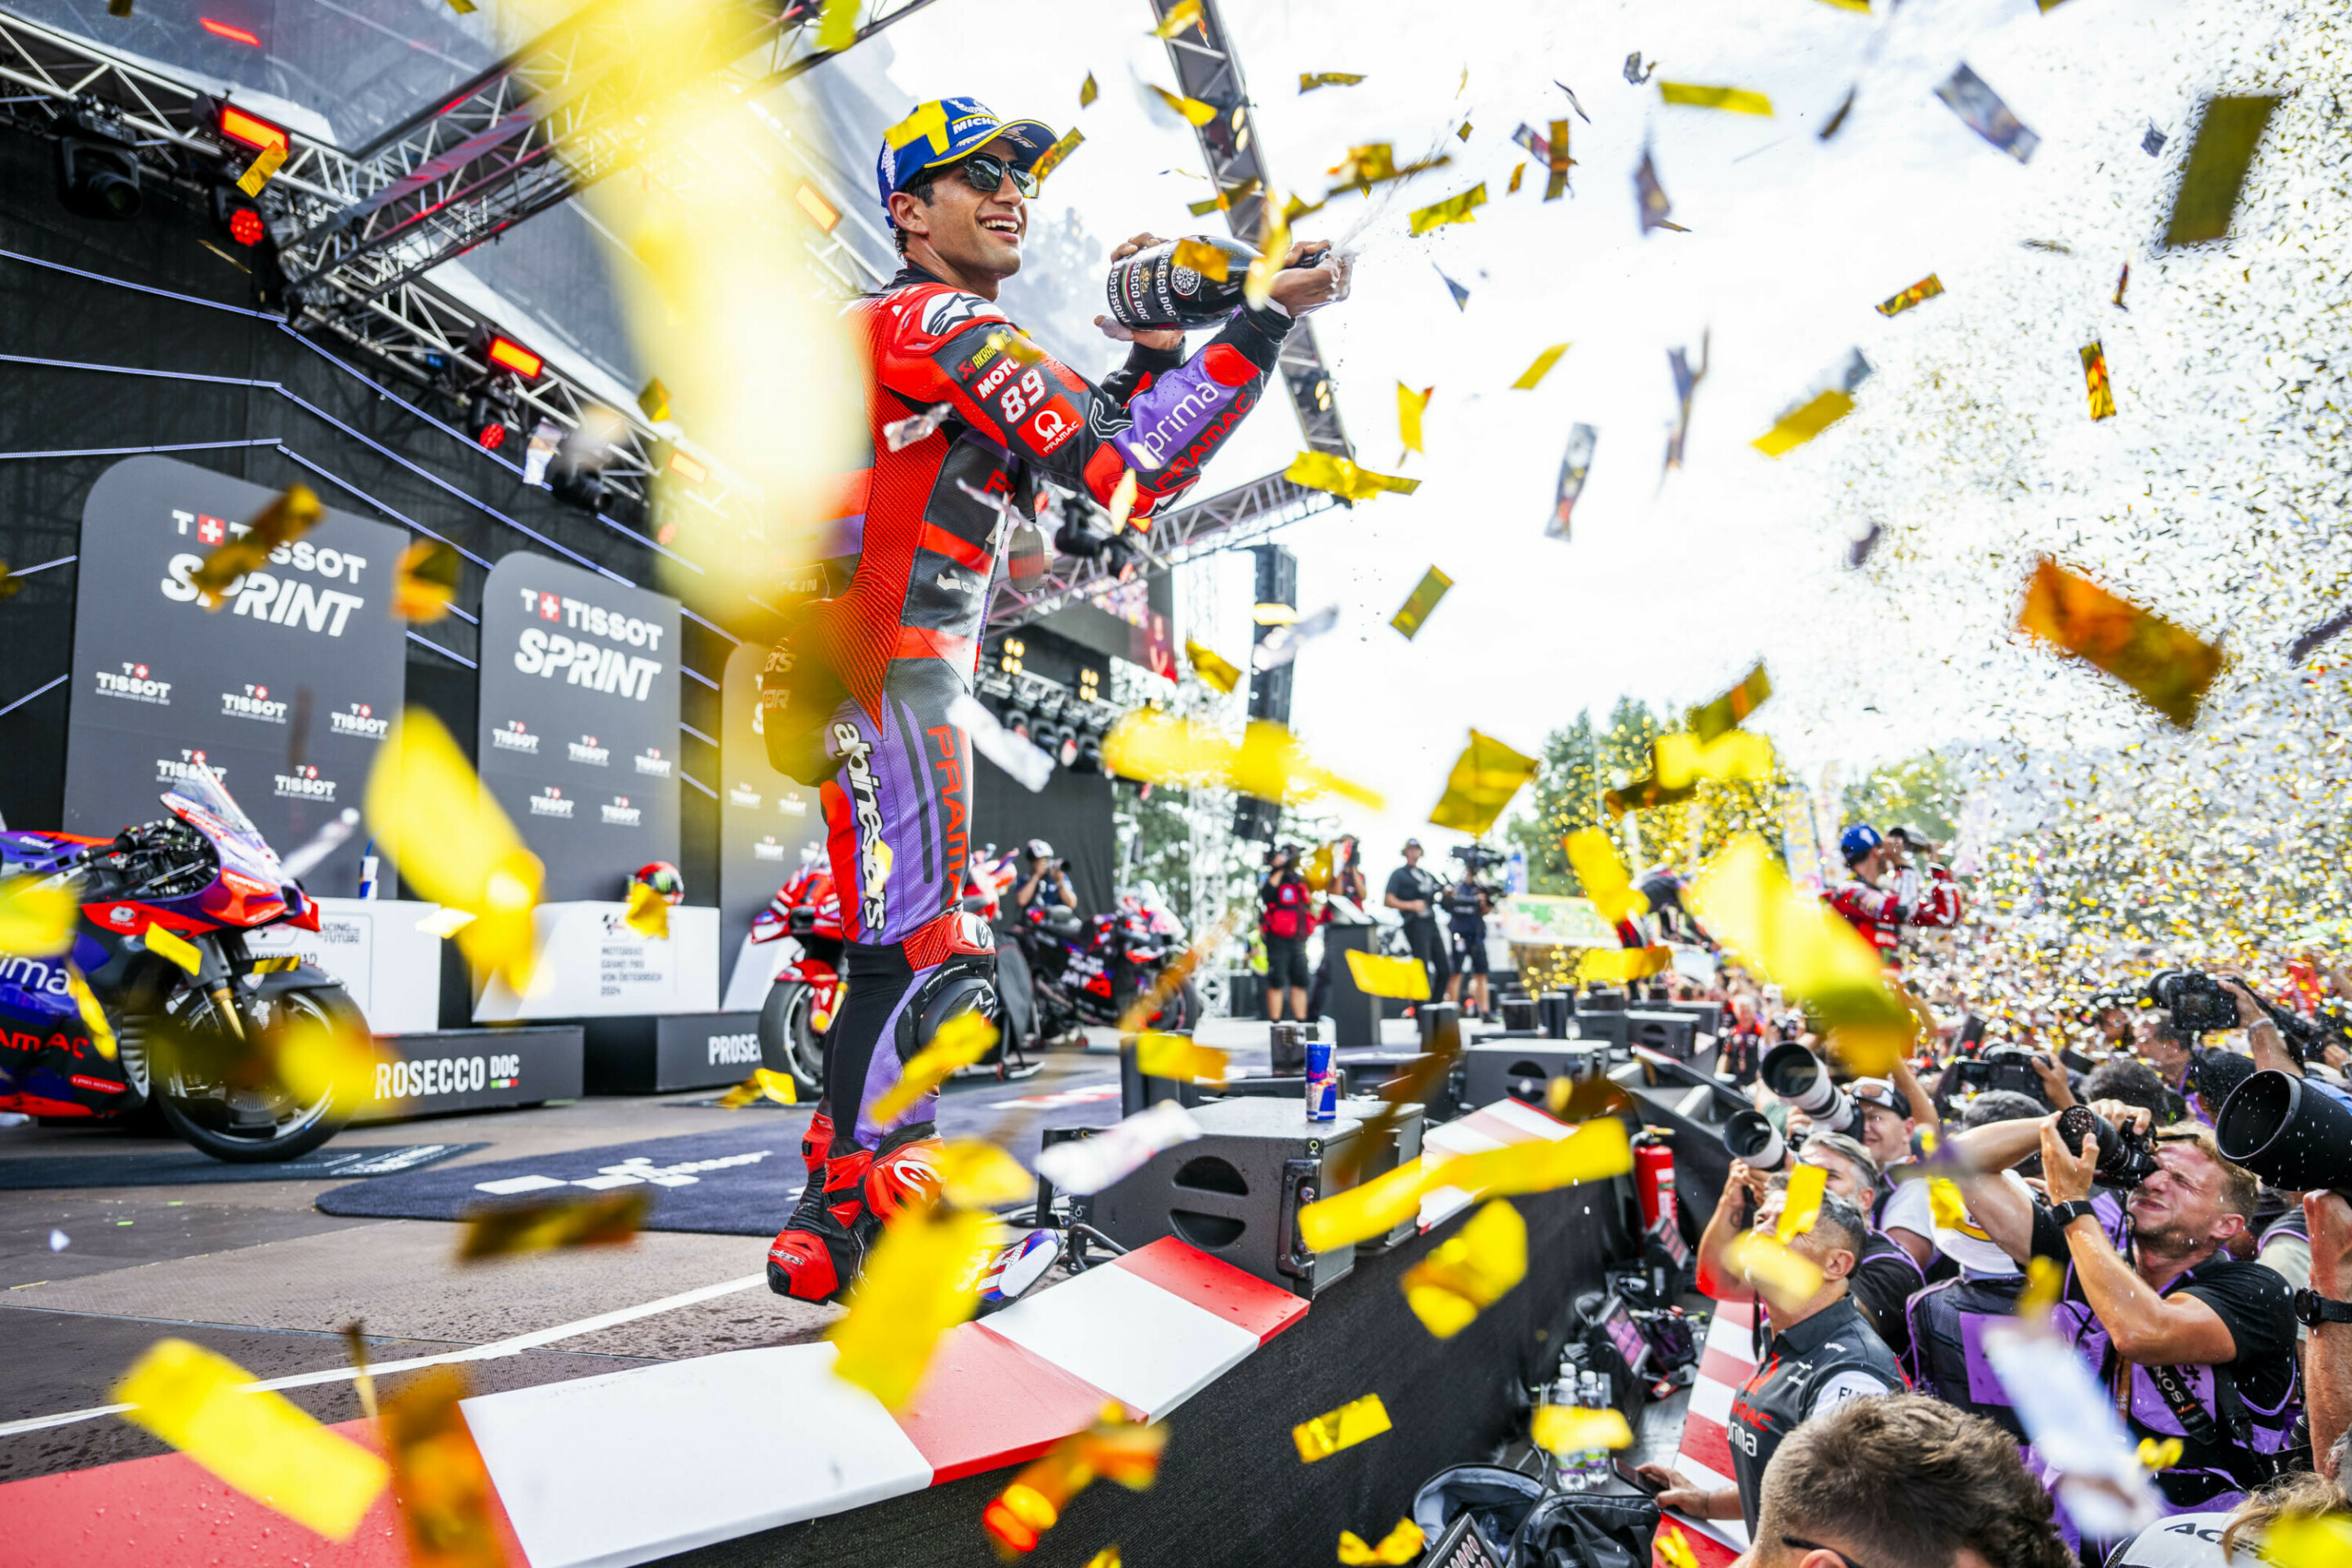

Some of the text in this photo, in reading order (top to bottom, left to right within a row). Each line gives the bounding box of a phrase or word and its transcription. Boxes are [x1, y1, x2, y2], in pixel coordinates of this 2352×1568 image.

[1110, 270, 1130, 323] PROSECCO
[1156, 252, 1177, 317] OSECCO DOC
[1134, 301, 1151, 320] DOC
[978, 358, 1021, 399] MOTU
[1000, 367, 1046, 424] 89
[1043, 421, 1080, 453] PRAMAC
[1144, 382, 1219, 461] prima
[1154, 392, 1254, 491] PRAMAC
[229, 521, 367, 584] TSSOT
[563, 597, 663, 651] TISSOT
[96, 671, 172, 698] TISSOT
[514, 627, 662, 702] SPRINT
[221, 693, 287, 718] TISSOT
[331, 711, 389, 735] TISSOT
[274, 774, 336, 796] TISSOT
[927, 725, 968, 908] PRAMA
[0, 950, 71, 996] ima
[708, 1033, 762, 1066] PROSE
[374, 1054, 520, 1099] ROSECCO DOC
[2154, 1365, 2185, 1403] SON
